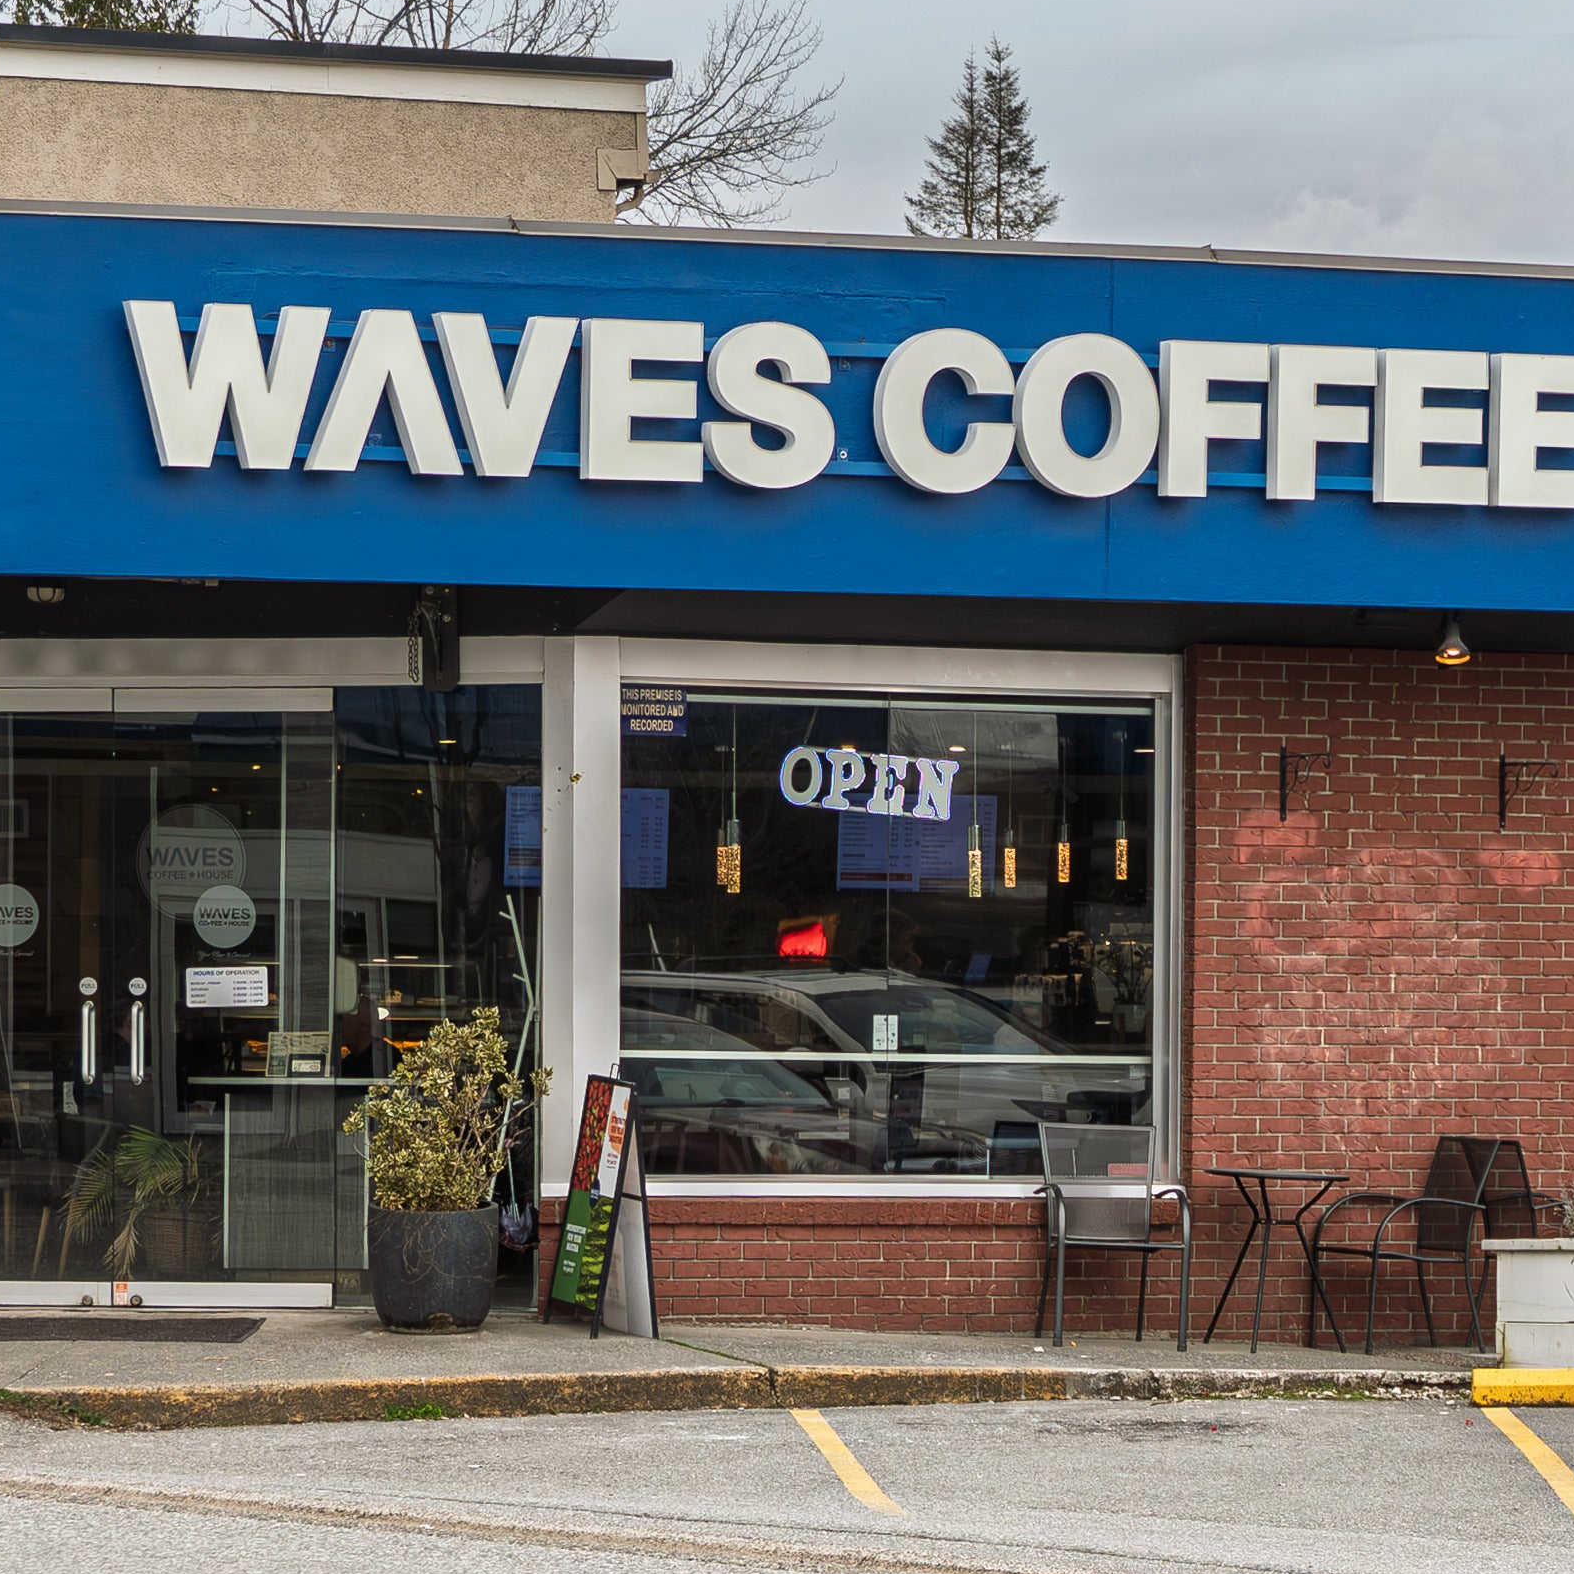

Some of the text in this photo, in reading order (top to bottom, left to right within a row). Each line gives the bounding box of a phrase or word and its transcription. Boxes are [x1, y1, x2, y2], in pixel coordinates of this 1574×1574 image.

[122, 300, 836, 490] WAVES
[621, 688, 683, 701] THIS PREMISE IS
[667, 704, 684, 717] AND
[630, 719, 674, 732] RECORDED
[779, 746, 960, 821] OPEN
[146, 846, 234, 867] WAVES
[146, 869, 234, 880] COFFEE HOUSE
[198, 907, 251, 920] WAVES
